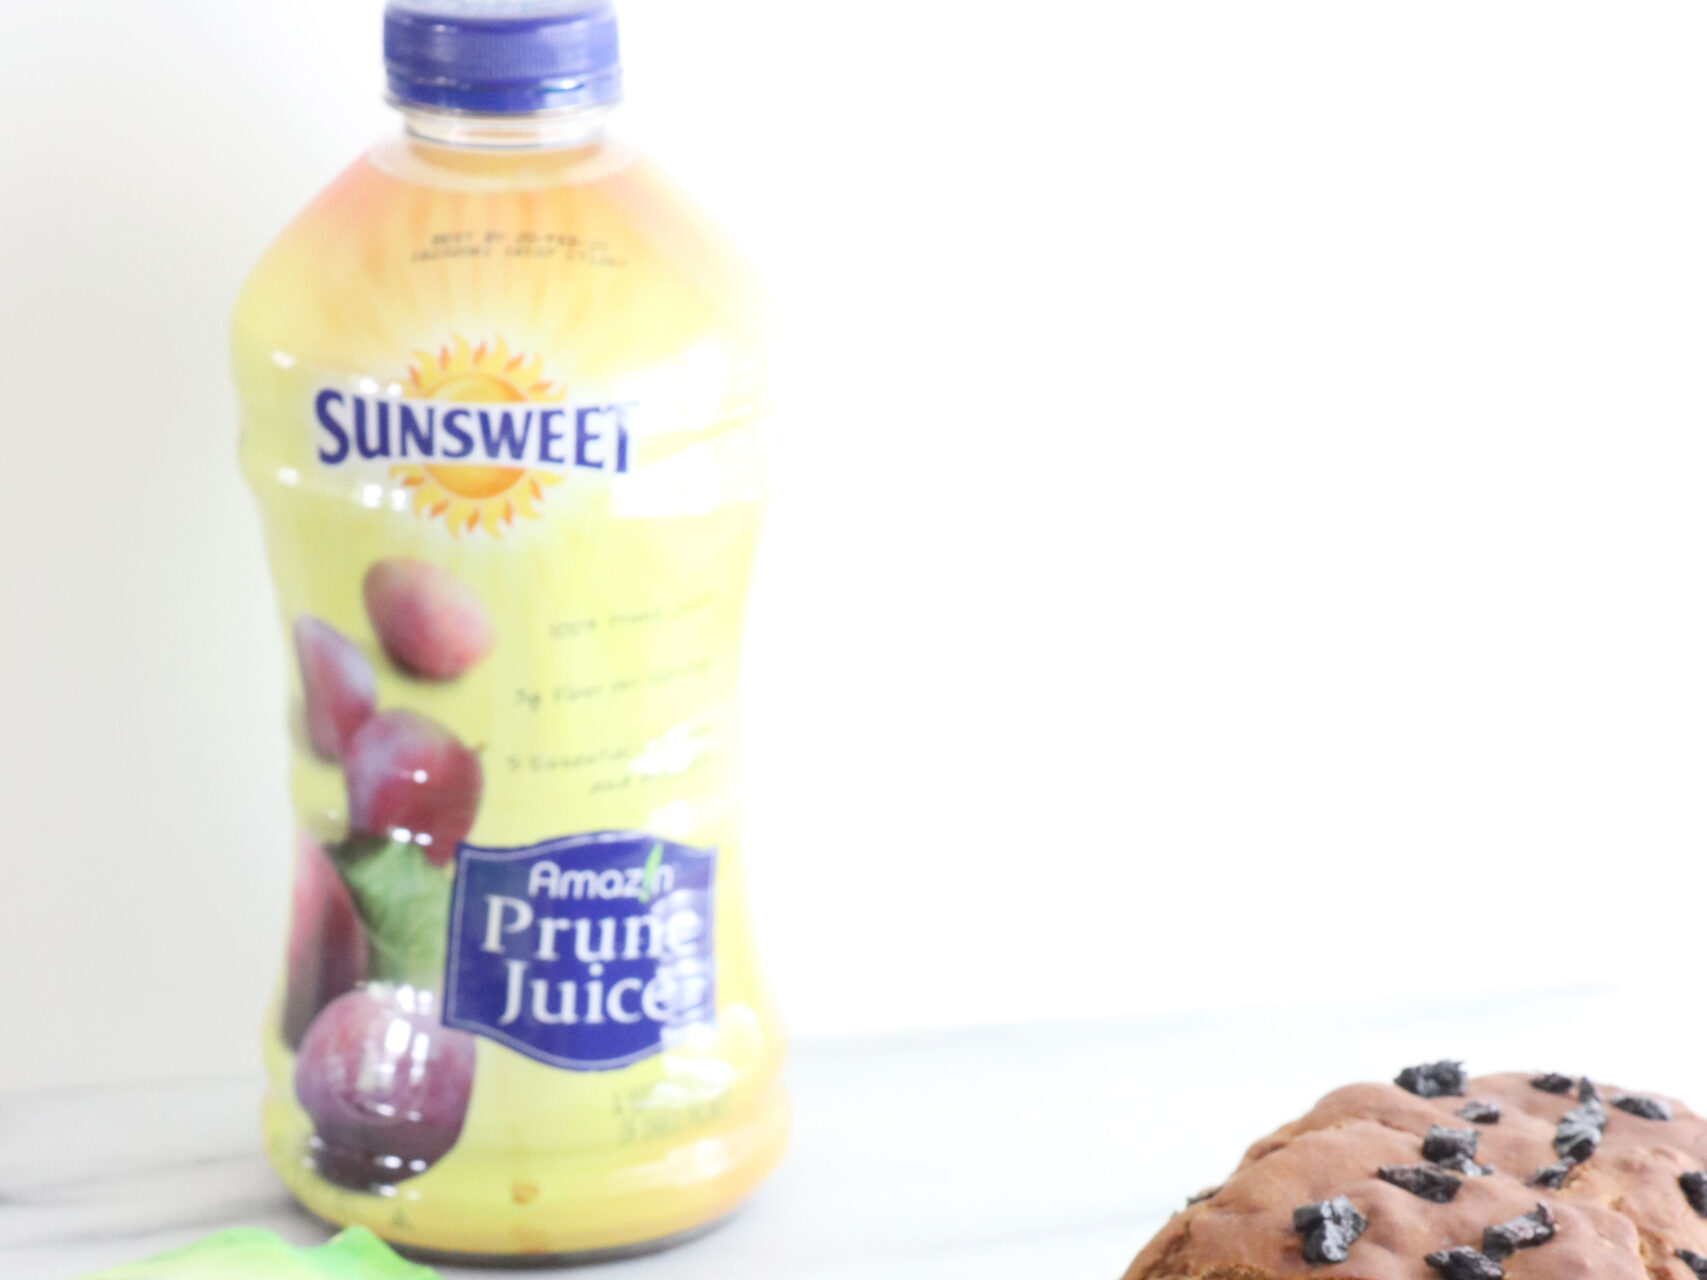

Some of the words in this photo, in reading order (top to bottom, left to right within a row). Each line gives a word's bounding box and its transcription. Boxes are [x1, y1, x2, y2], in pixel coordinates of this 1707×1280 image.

[313, 387, 639, 475] SUNSWEET
[480, 894, 702, 963] Prune
[500, 958, 695, 1026] Juice
